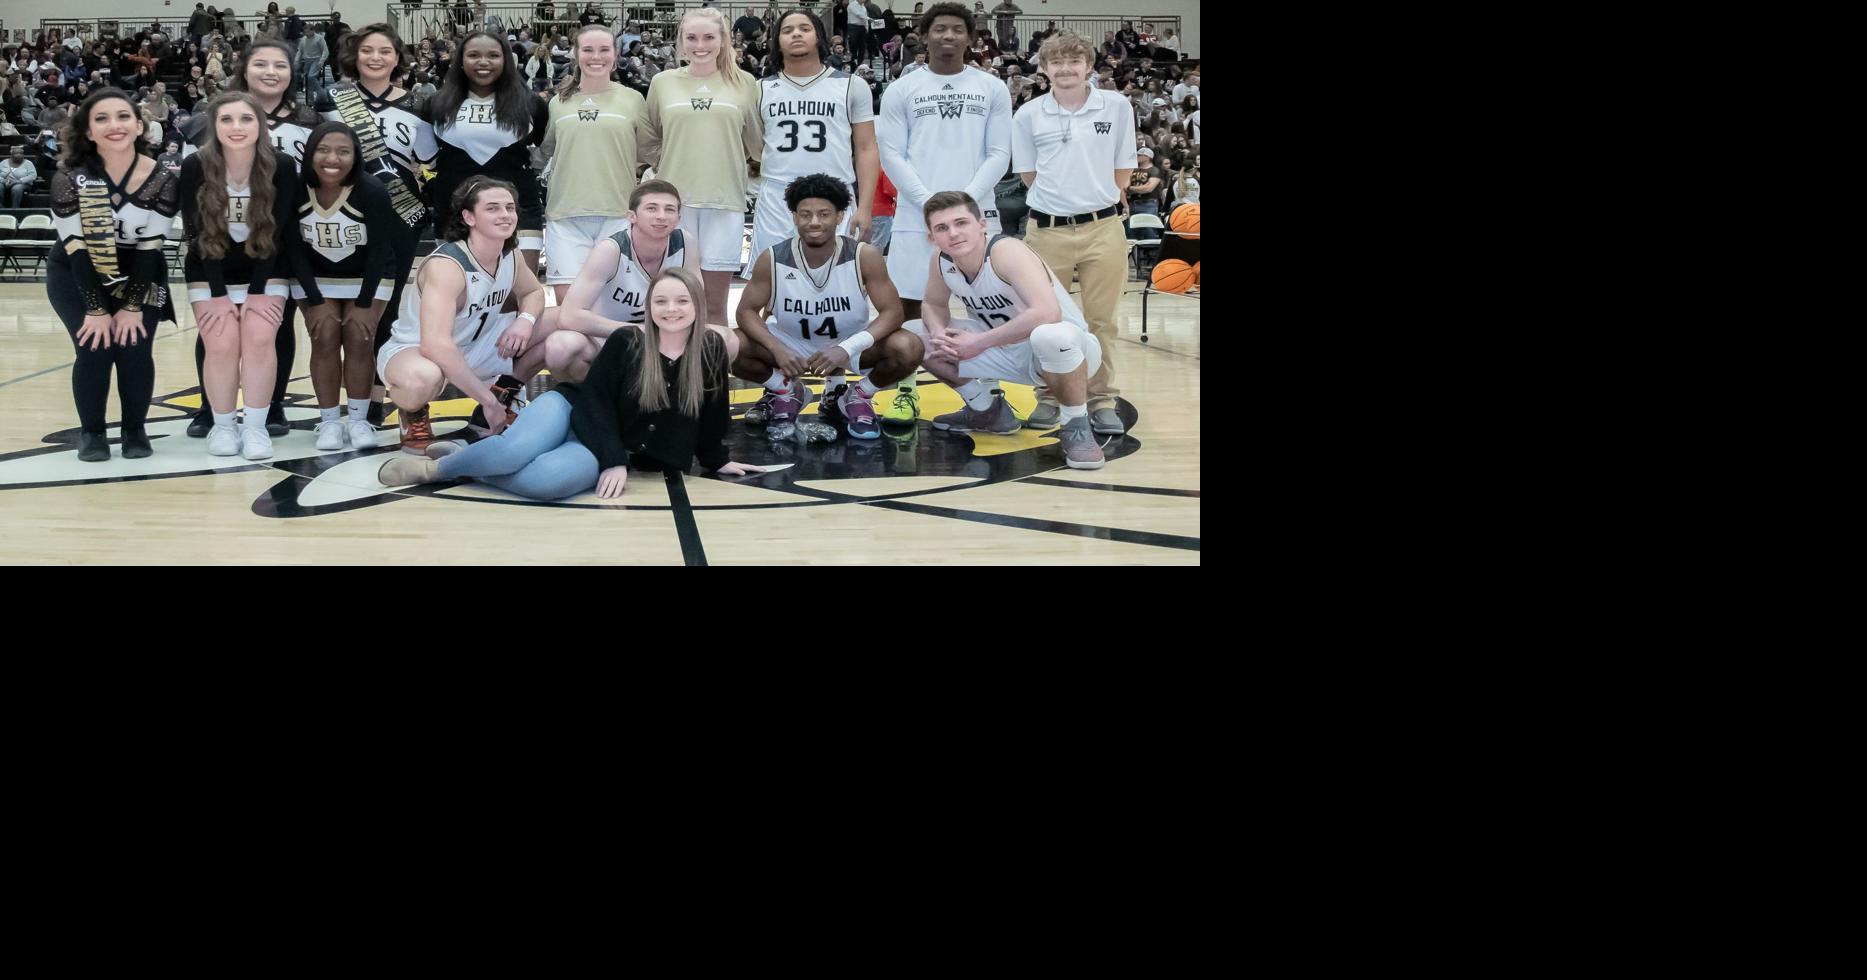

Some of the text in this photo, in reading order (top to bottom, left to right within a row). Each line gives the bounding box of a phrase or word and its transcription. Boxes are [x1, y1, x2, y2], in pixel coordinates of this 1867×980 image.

[769, 100, 836, 118] CALHOUN
[914, 93, 986, 104] CALHOUN MENTALITY
[333, 91, 391, 163] DANCE TEAM
[776, 120, 827, 153] 33
[405, 206, 427, 228] 2020
[79, 187, 120, 275] DANCE TEAM
[301, 221, 363, 249] CHS
[783, 296, 851, 316] CALHOUN
[798, 316, 839, 340] 14
